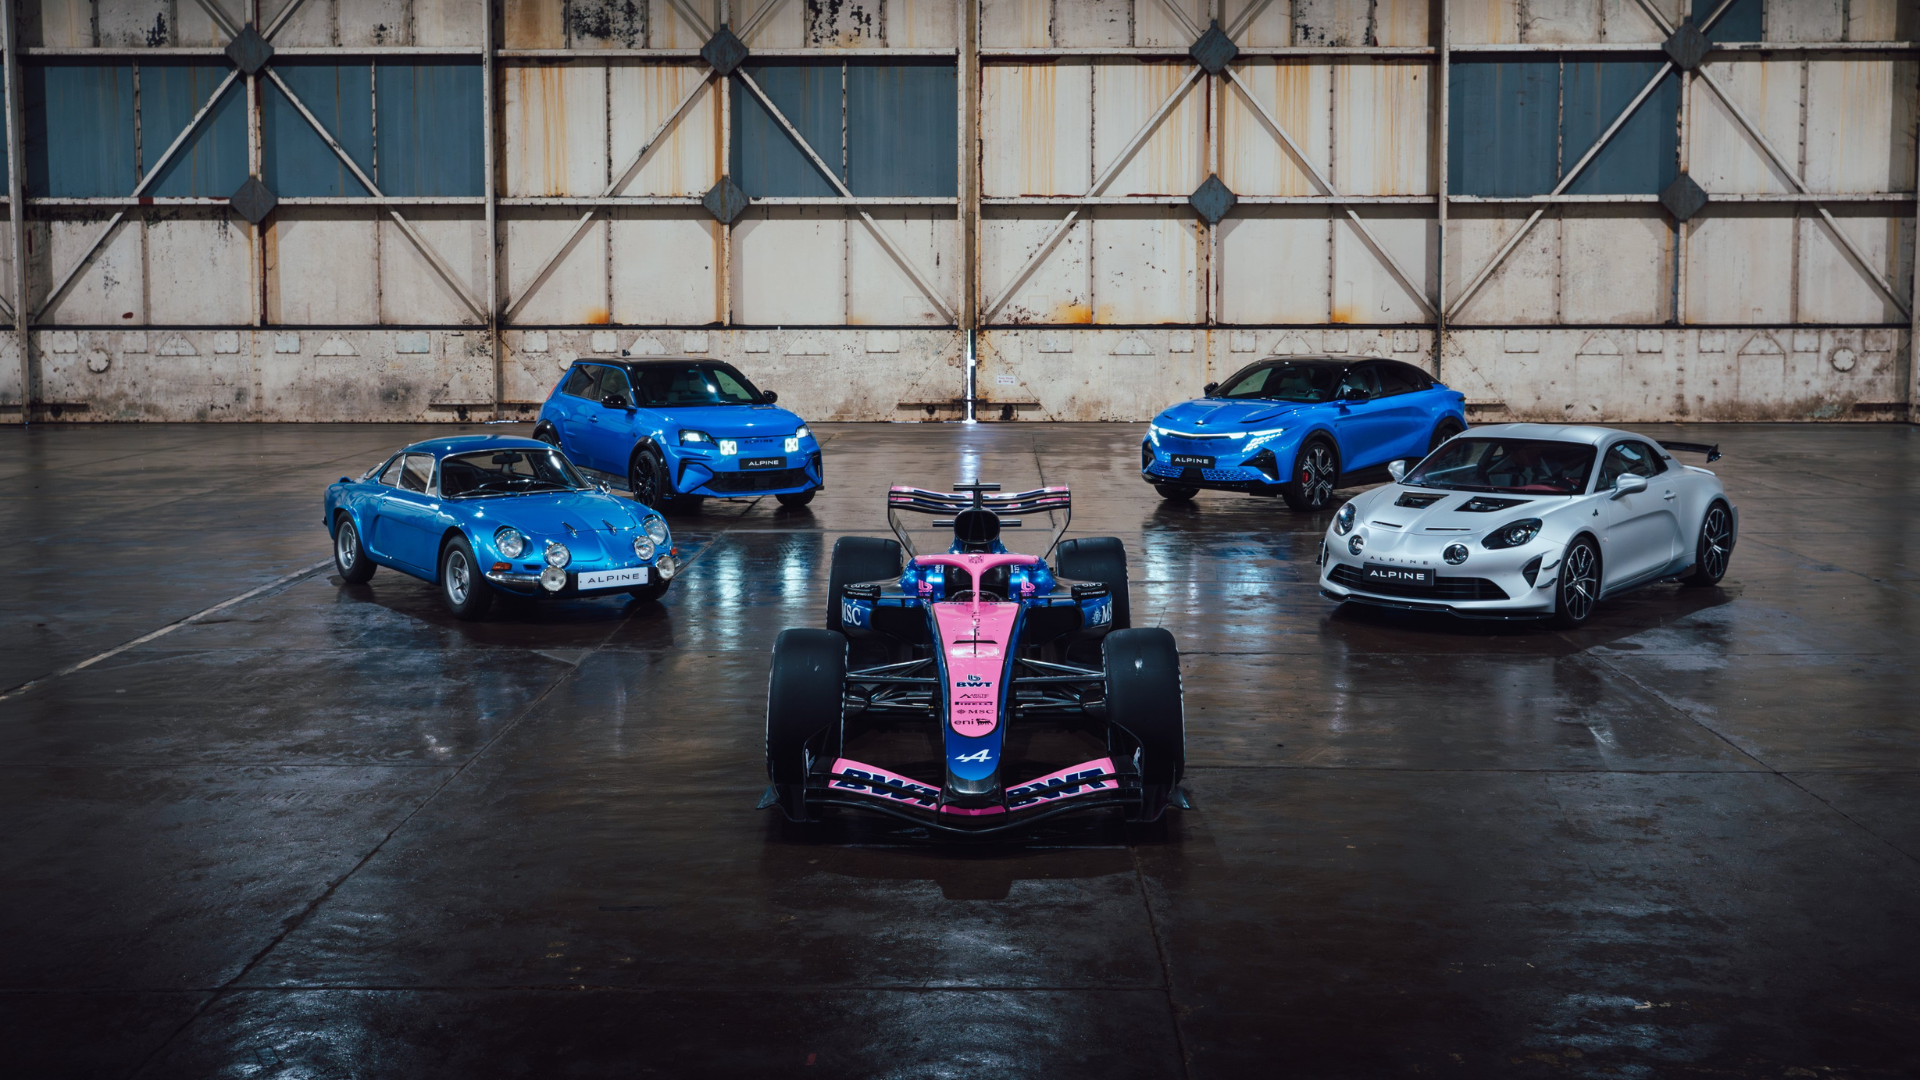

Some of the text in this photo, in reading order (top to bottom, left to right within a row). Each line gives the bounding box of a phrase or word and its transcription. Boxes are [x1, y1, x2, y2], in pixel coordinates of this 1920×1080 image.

[1370, 556, 1428, 565] ALPINE
[587, 573, 640, 583] ALPINE
[1369, 570, 1425, 580] ALPINE
[832, 767, 940, 808] BWT
[1005, 767, 1109, 809] BWT
